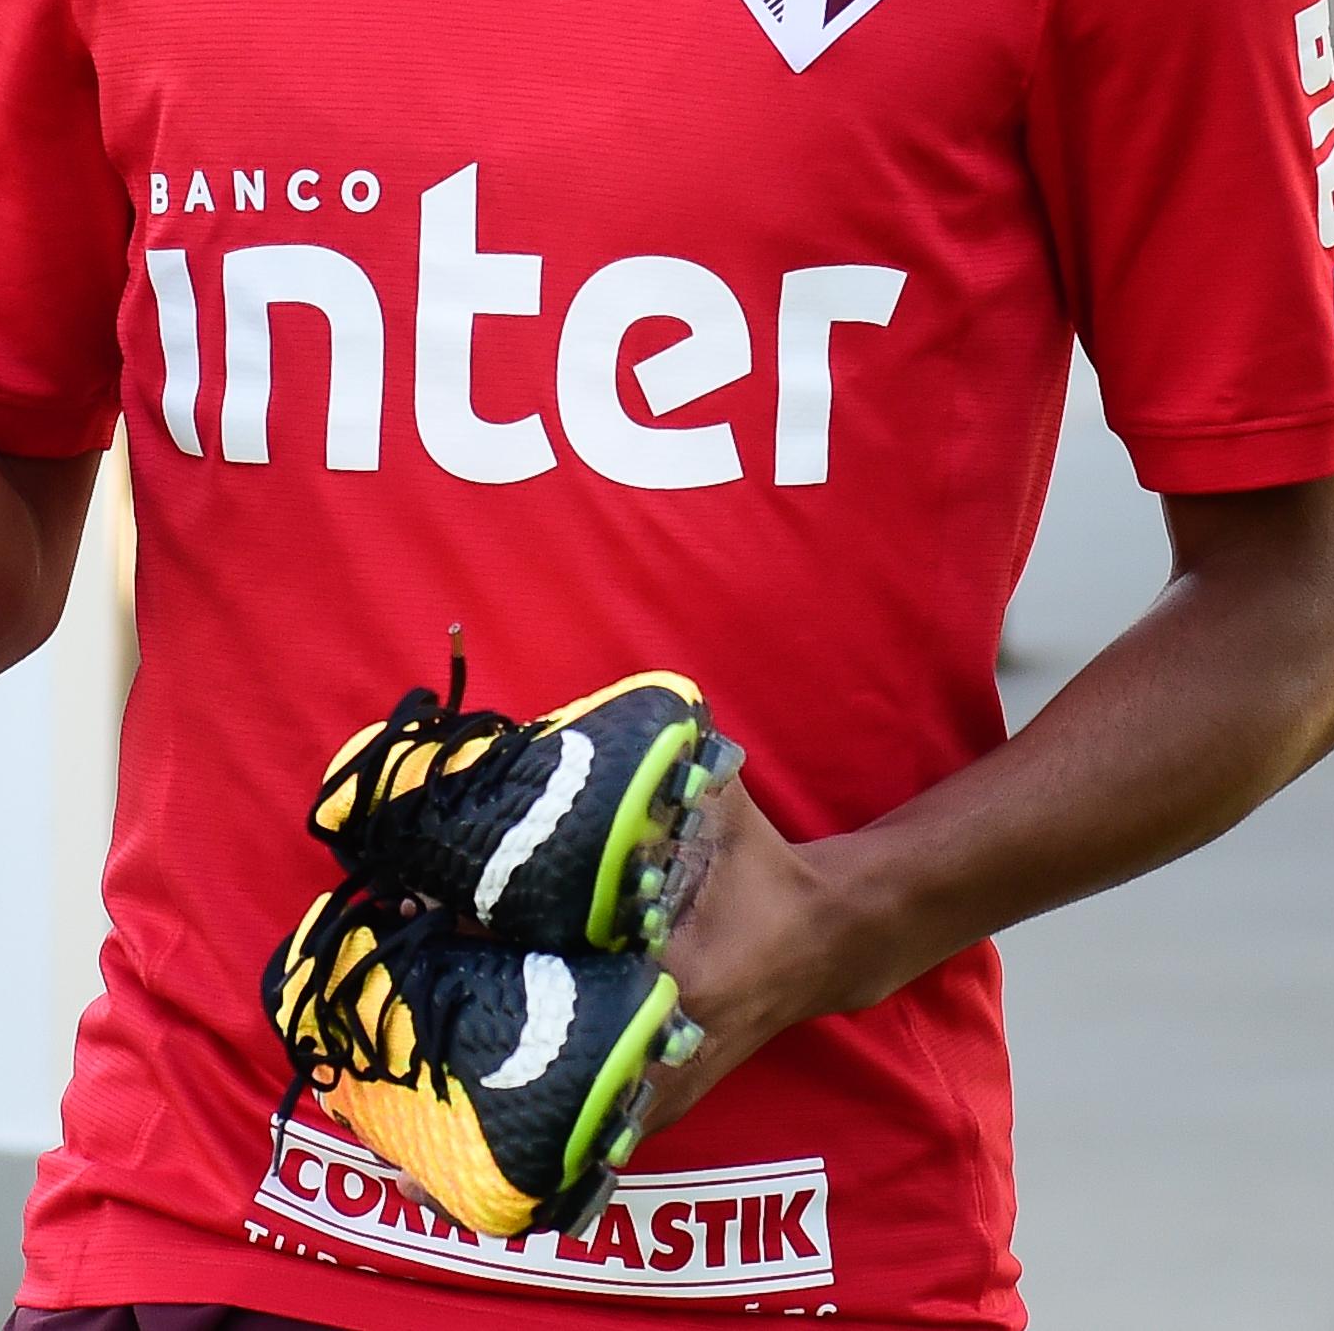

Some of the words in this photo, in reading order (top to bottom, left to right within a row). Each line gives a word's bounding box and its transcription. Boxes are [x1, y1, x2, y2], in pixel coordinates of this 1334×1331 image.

[150, 169, 381, 214] BANCO
[145, 162, 908, 490] inter
[504, 1187, 821, 1272] LASTIK
